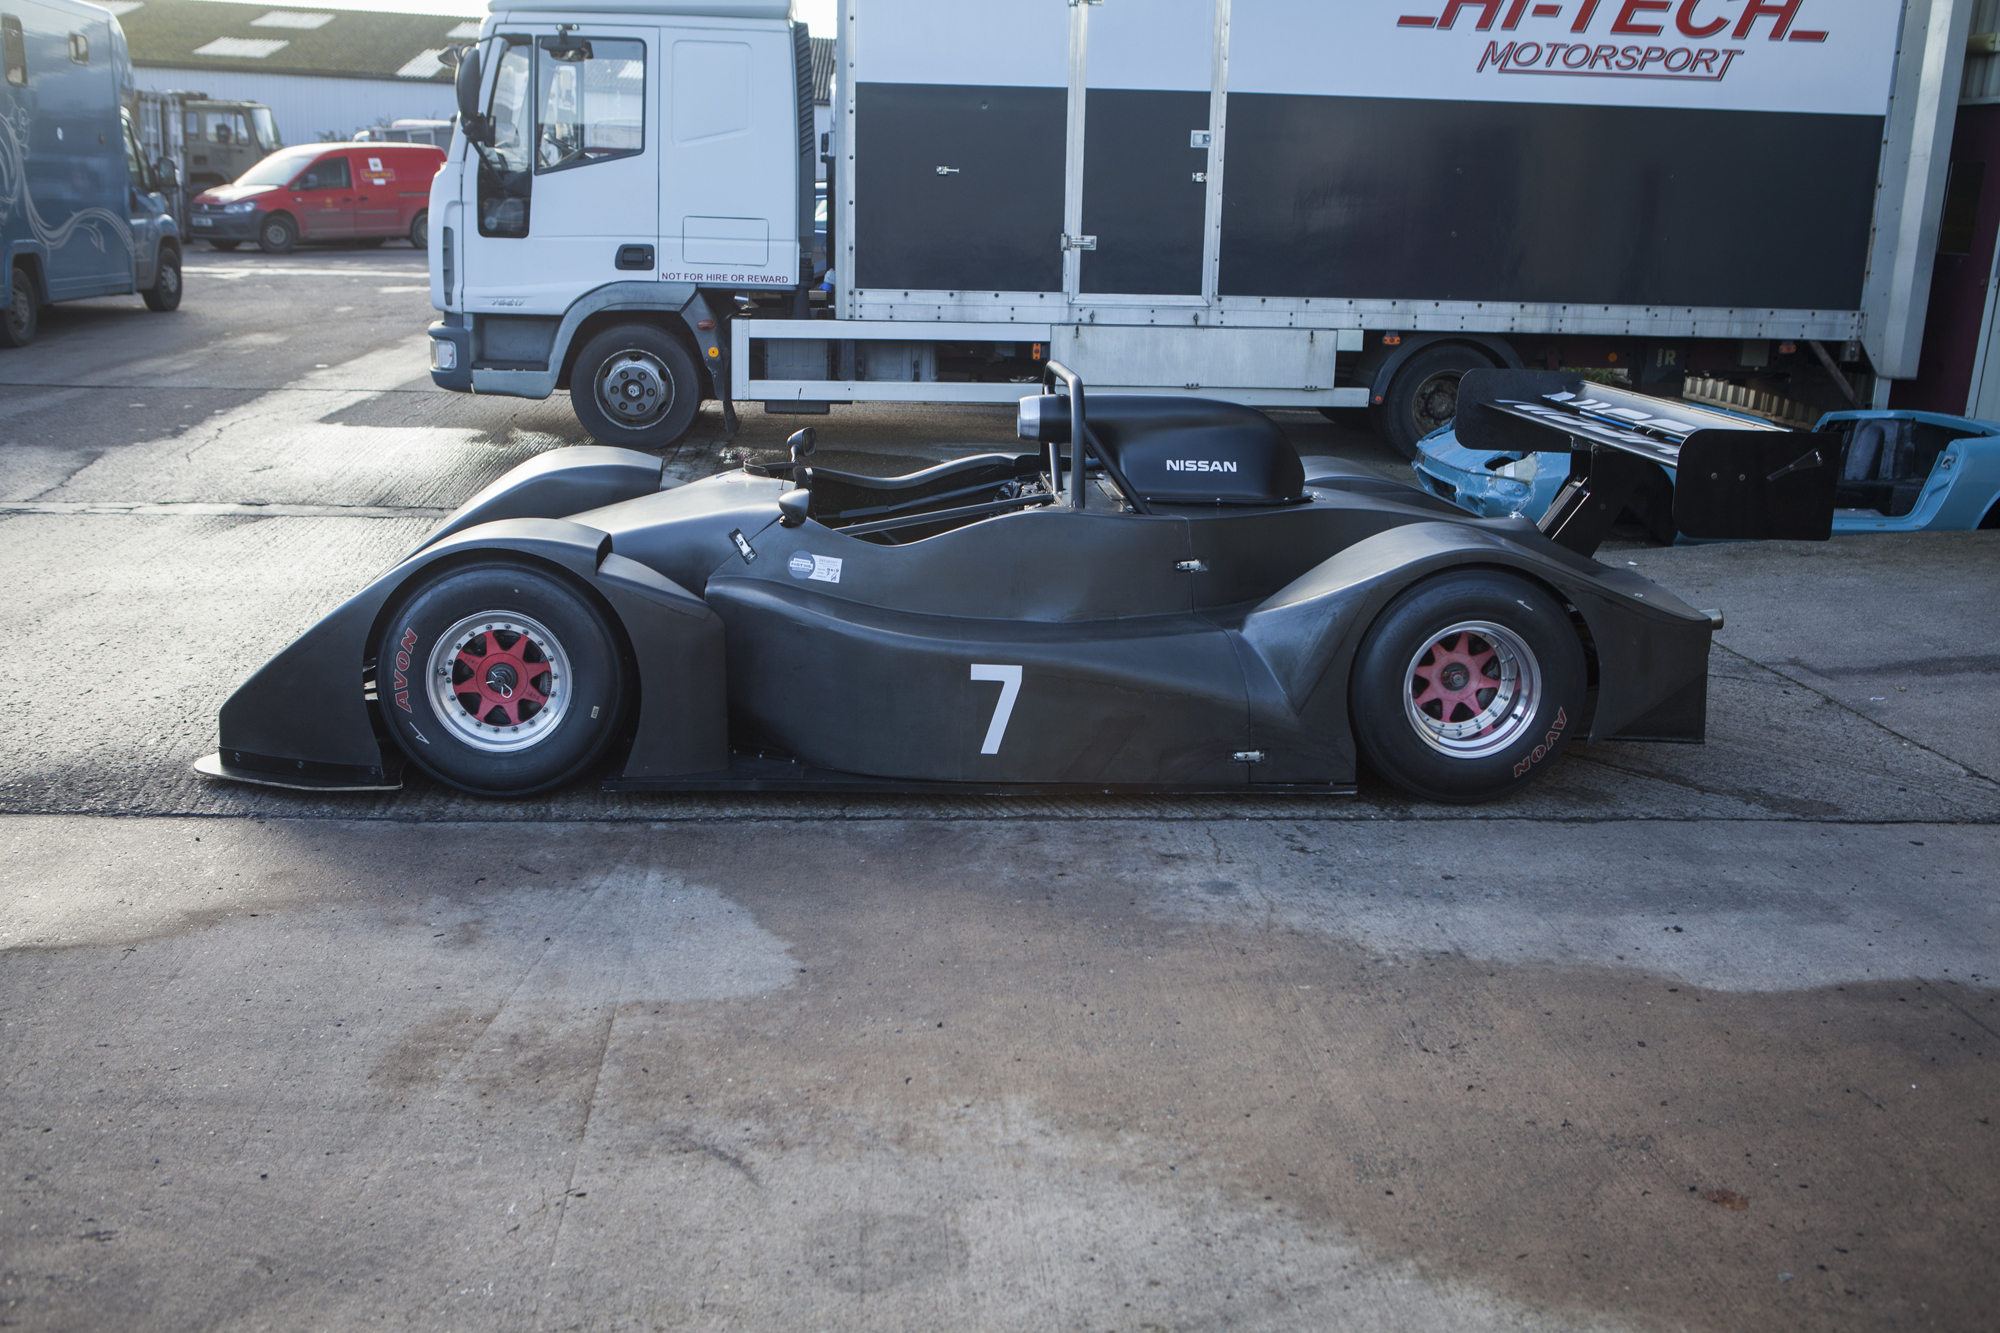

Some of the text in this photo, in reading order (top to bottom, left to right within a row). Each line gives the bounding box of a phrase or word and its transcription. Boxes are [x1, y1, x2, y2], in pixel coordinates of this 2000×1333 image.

[1477, 41, 1745, 81] MOTORSPORT
[662, 272, 789, 283] NOT FOR HIRE OR REWARD
[1166, 459, 1237, 473] NISSAN
[394, 627, 419, 714] AVON
[970, 663, 1023, 755] 7
[1513, 705, 1568, 779] AVON
